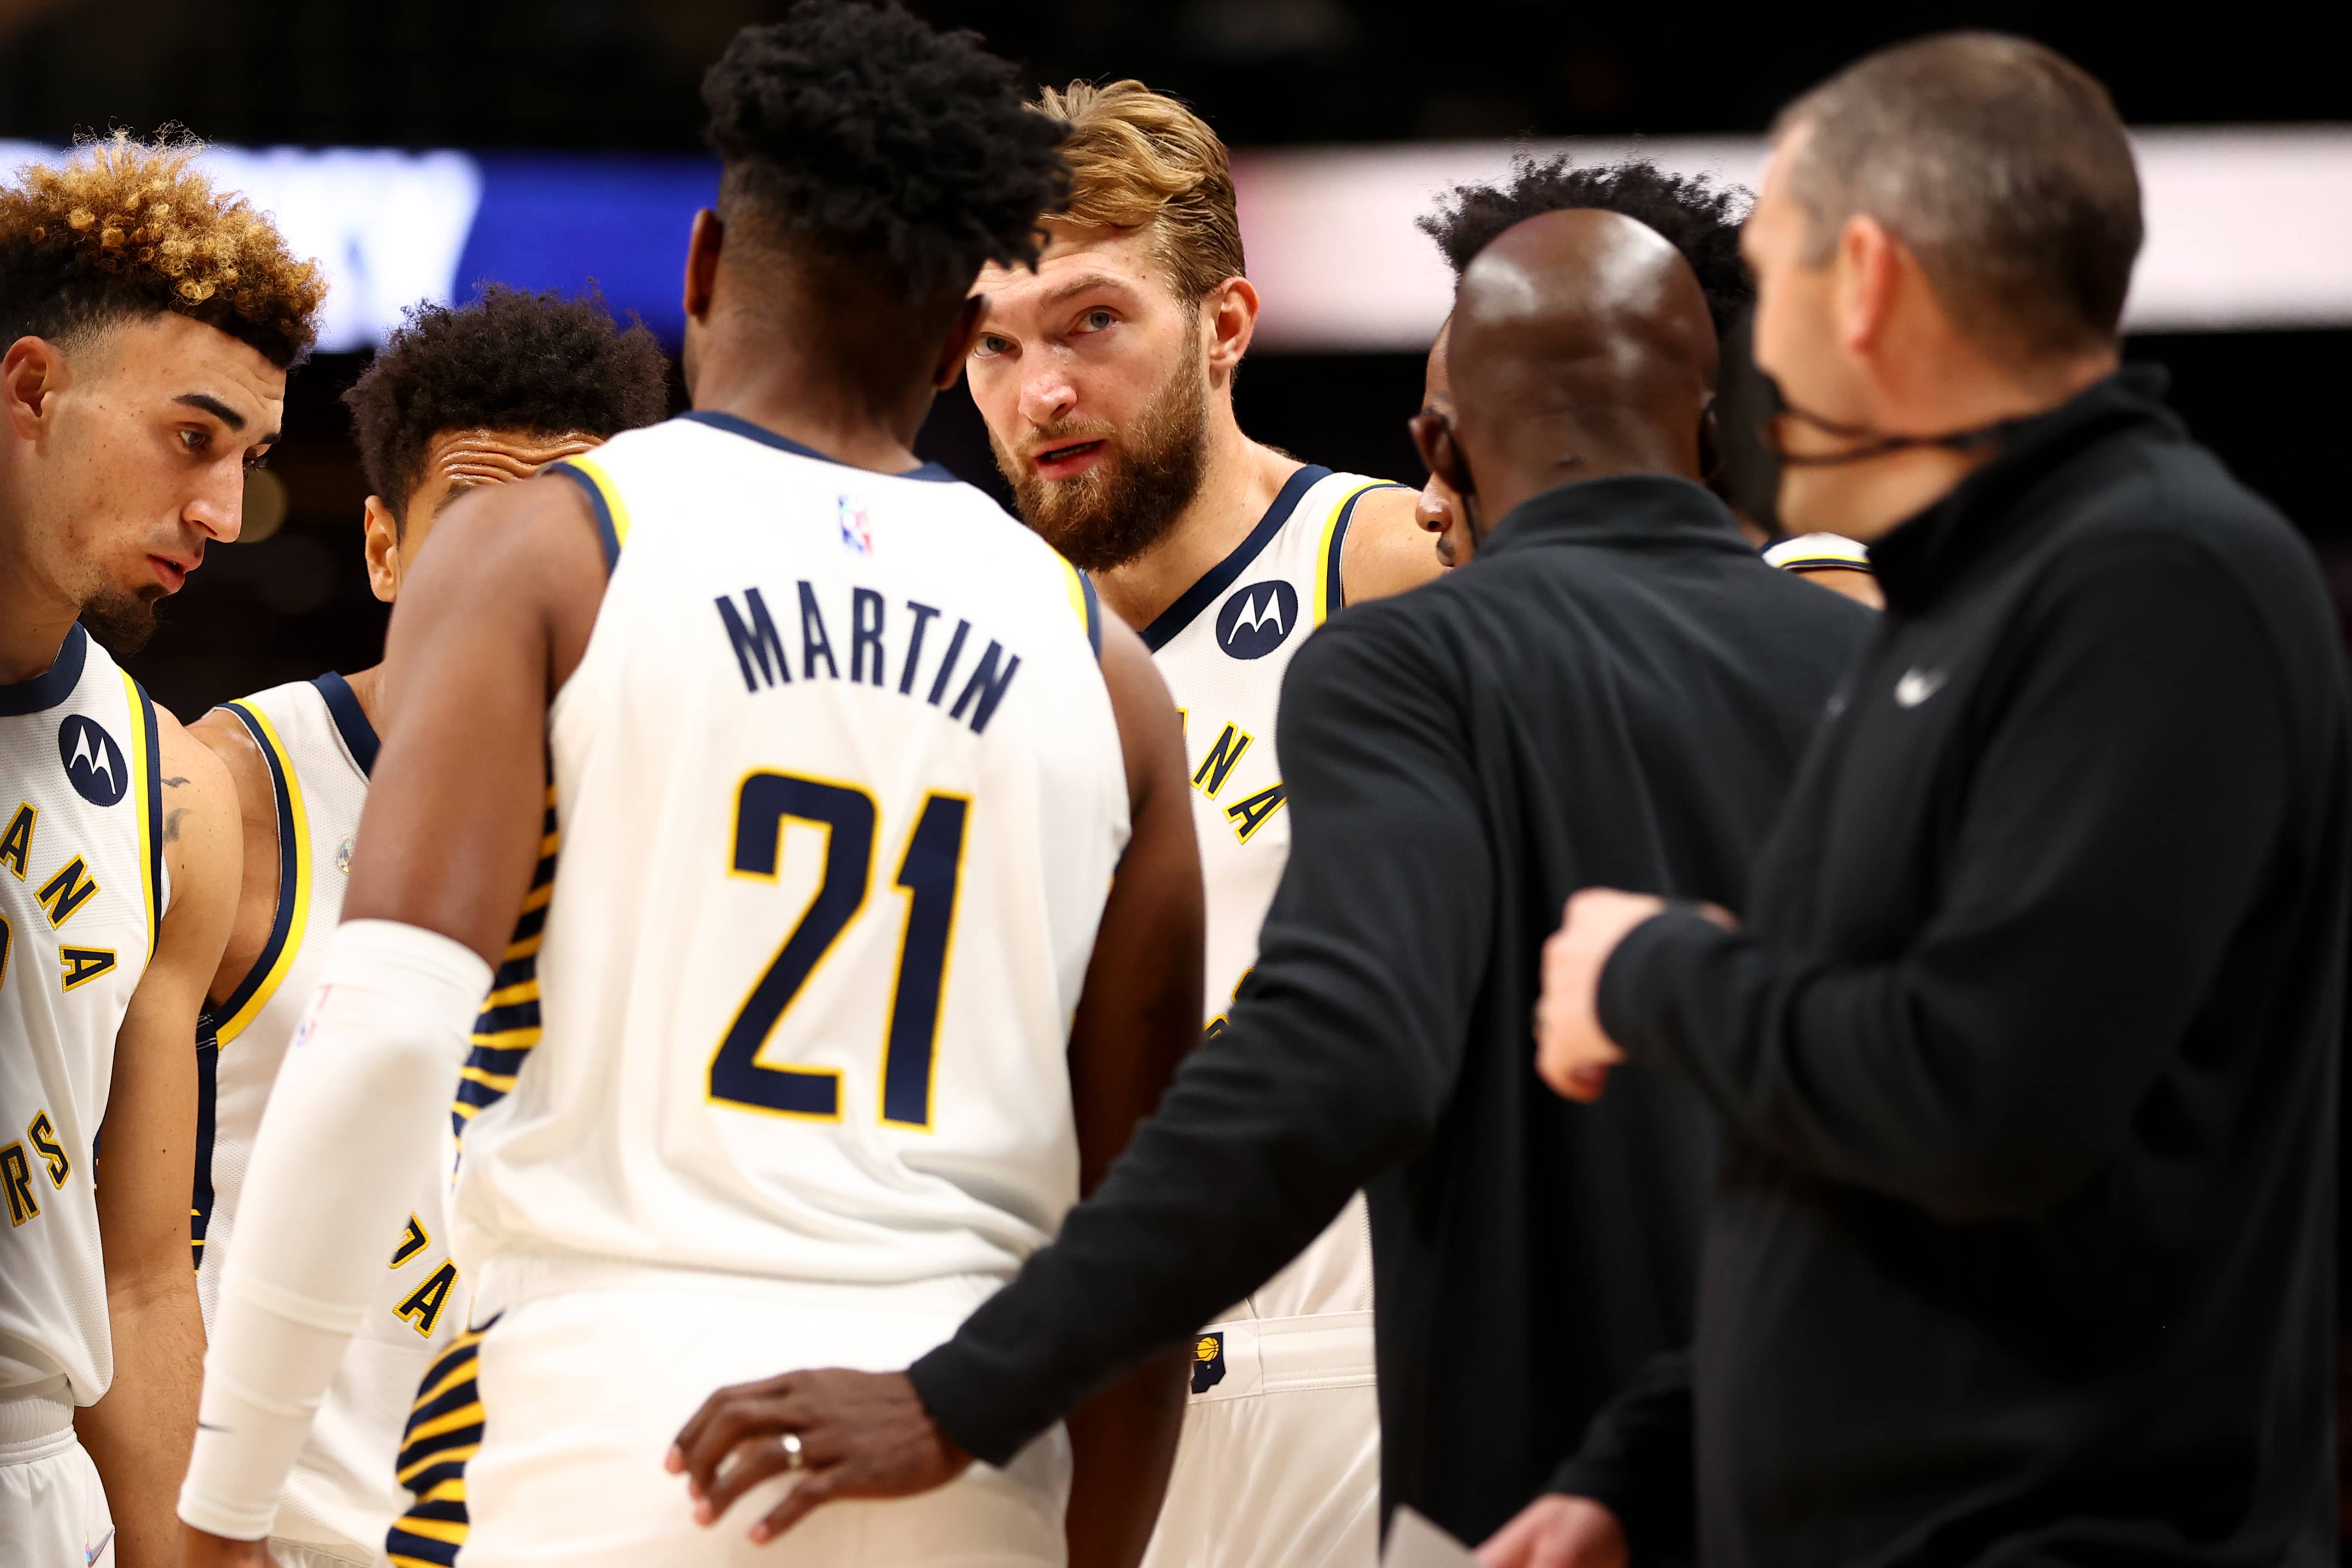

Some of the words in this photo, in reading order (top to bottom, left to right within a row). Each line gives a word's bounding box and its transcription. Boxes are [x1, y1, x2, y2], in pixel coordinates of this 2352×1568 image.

[714, 580, 1022, 735] MARTIN
[1176, 707, 1288, 845] NA
[0, 800, 117, 993] ANA
[705, 763, 974, 1134] 21
[0, 1109, 71, 1228] RS
